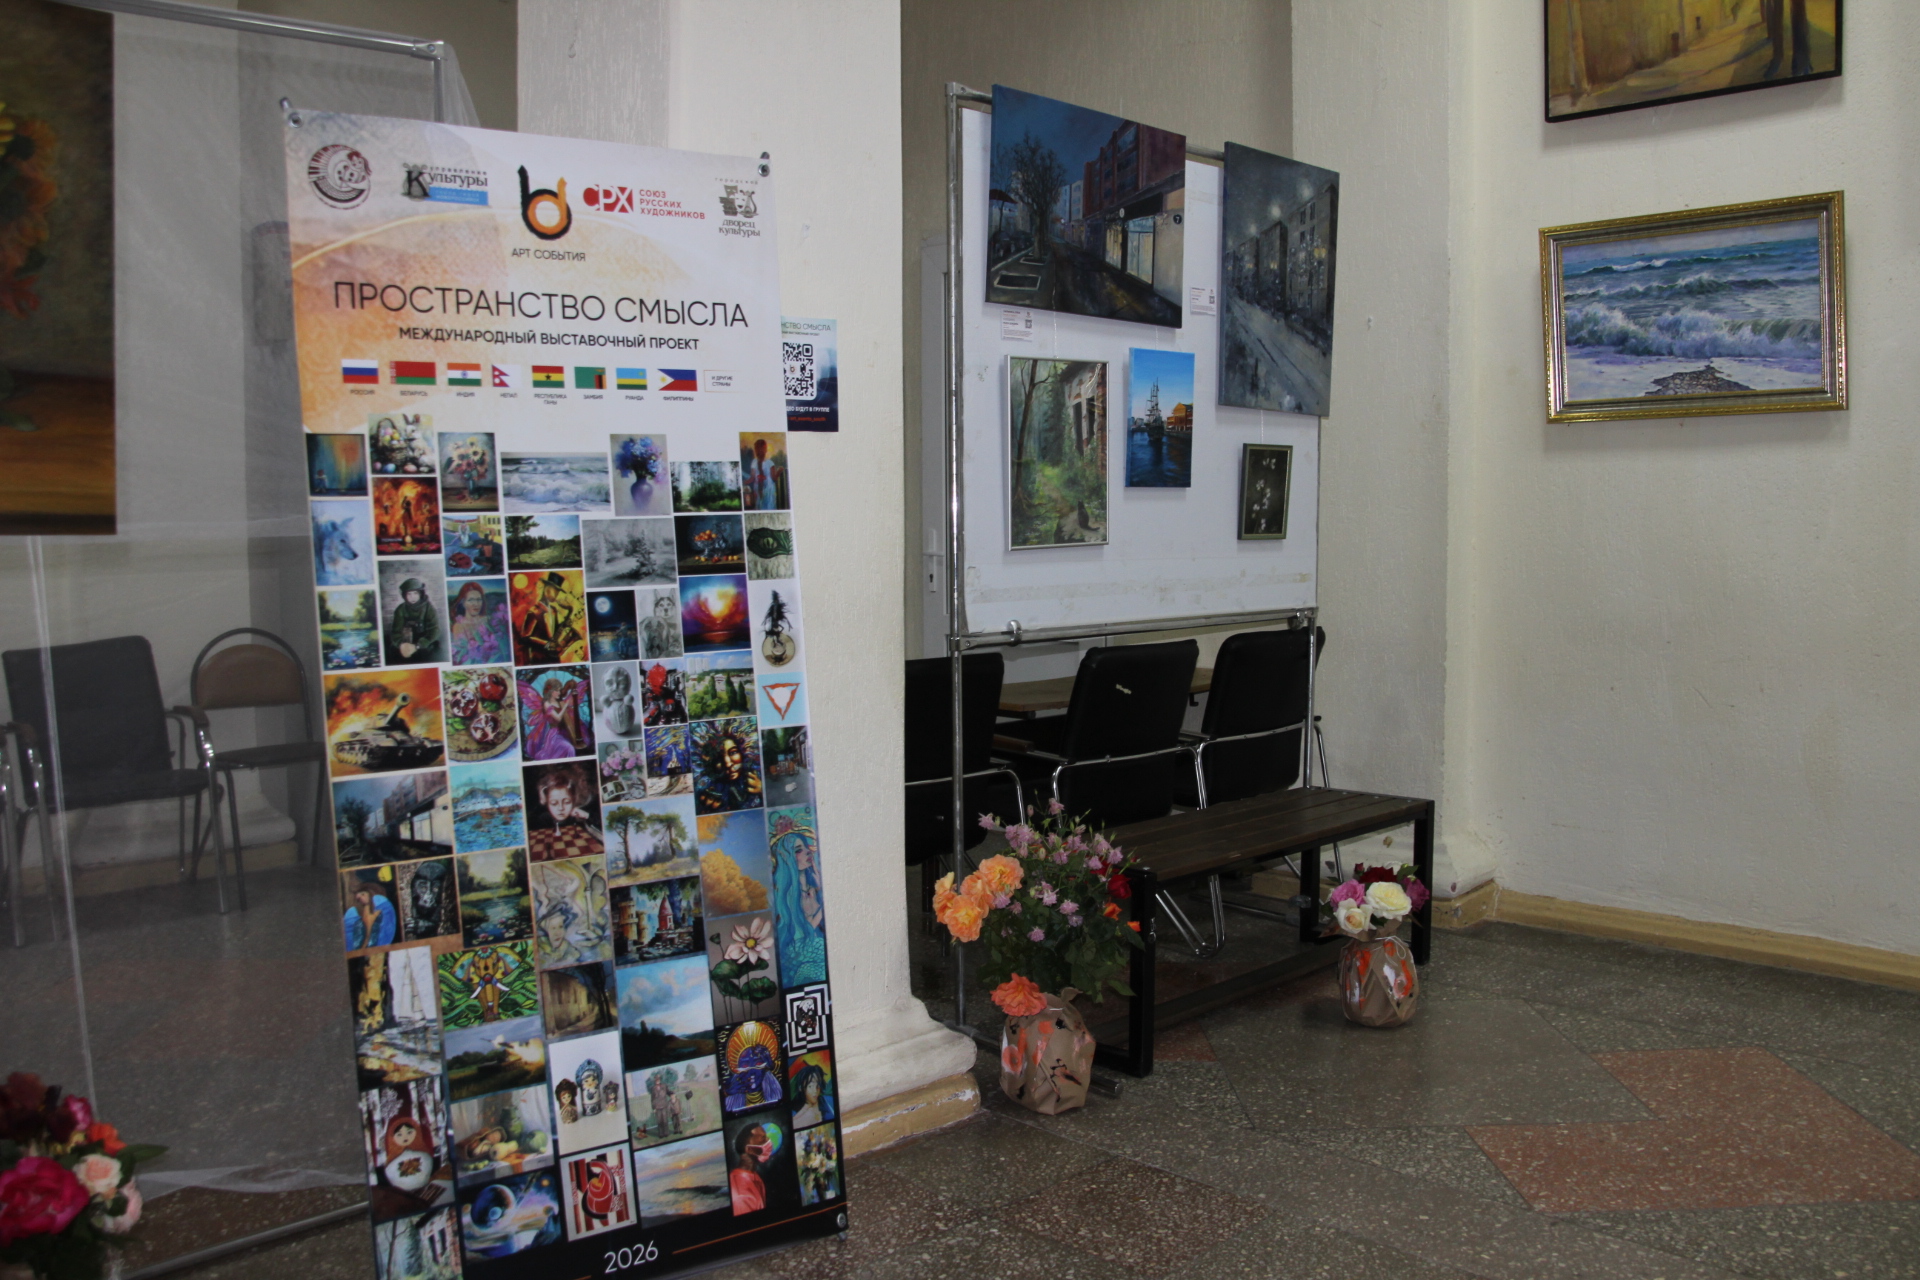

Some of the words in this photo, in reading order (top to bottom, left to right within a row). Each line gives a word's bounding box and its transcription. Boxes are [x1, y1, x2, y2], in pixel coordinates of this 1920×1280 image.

[402, 170, 488, 198] Культуры
[583, 184, 634, 214] СРХ
[639, 188, 667, 199] СОЮЗ
[639, 198, 682, 209] РУССКИХ
[640, 208, 706, 220] ХУДОЖНИКОВ
[719, 227, 761, 238] культуры
[511, 248, 532, 259] АРТ
[534, 249, 586, 262] СОБЫТИЯ
[334, 281, 606, 321] ПРОСТРАНСТВО
[614, 297, 749, 328] СМЫСЛА
[803, 323, 831, 331] СМЫСЛА
[400, 327, 537, 345] МЕЖДУНАРОДНЫЙ
[540, 332, 646, 349] ВЫСТАВОЧНЫЙ
[649, 337, 700, 350] ПРОЕКТ
[604, 1240, 659, 1274] 2026
